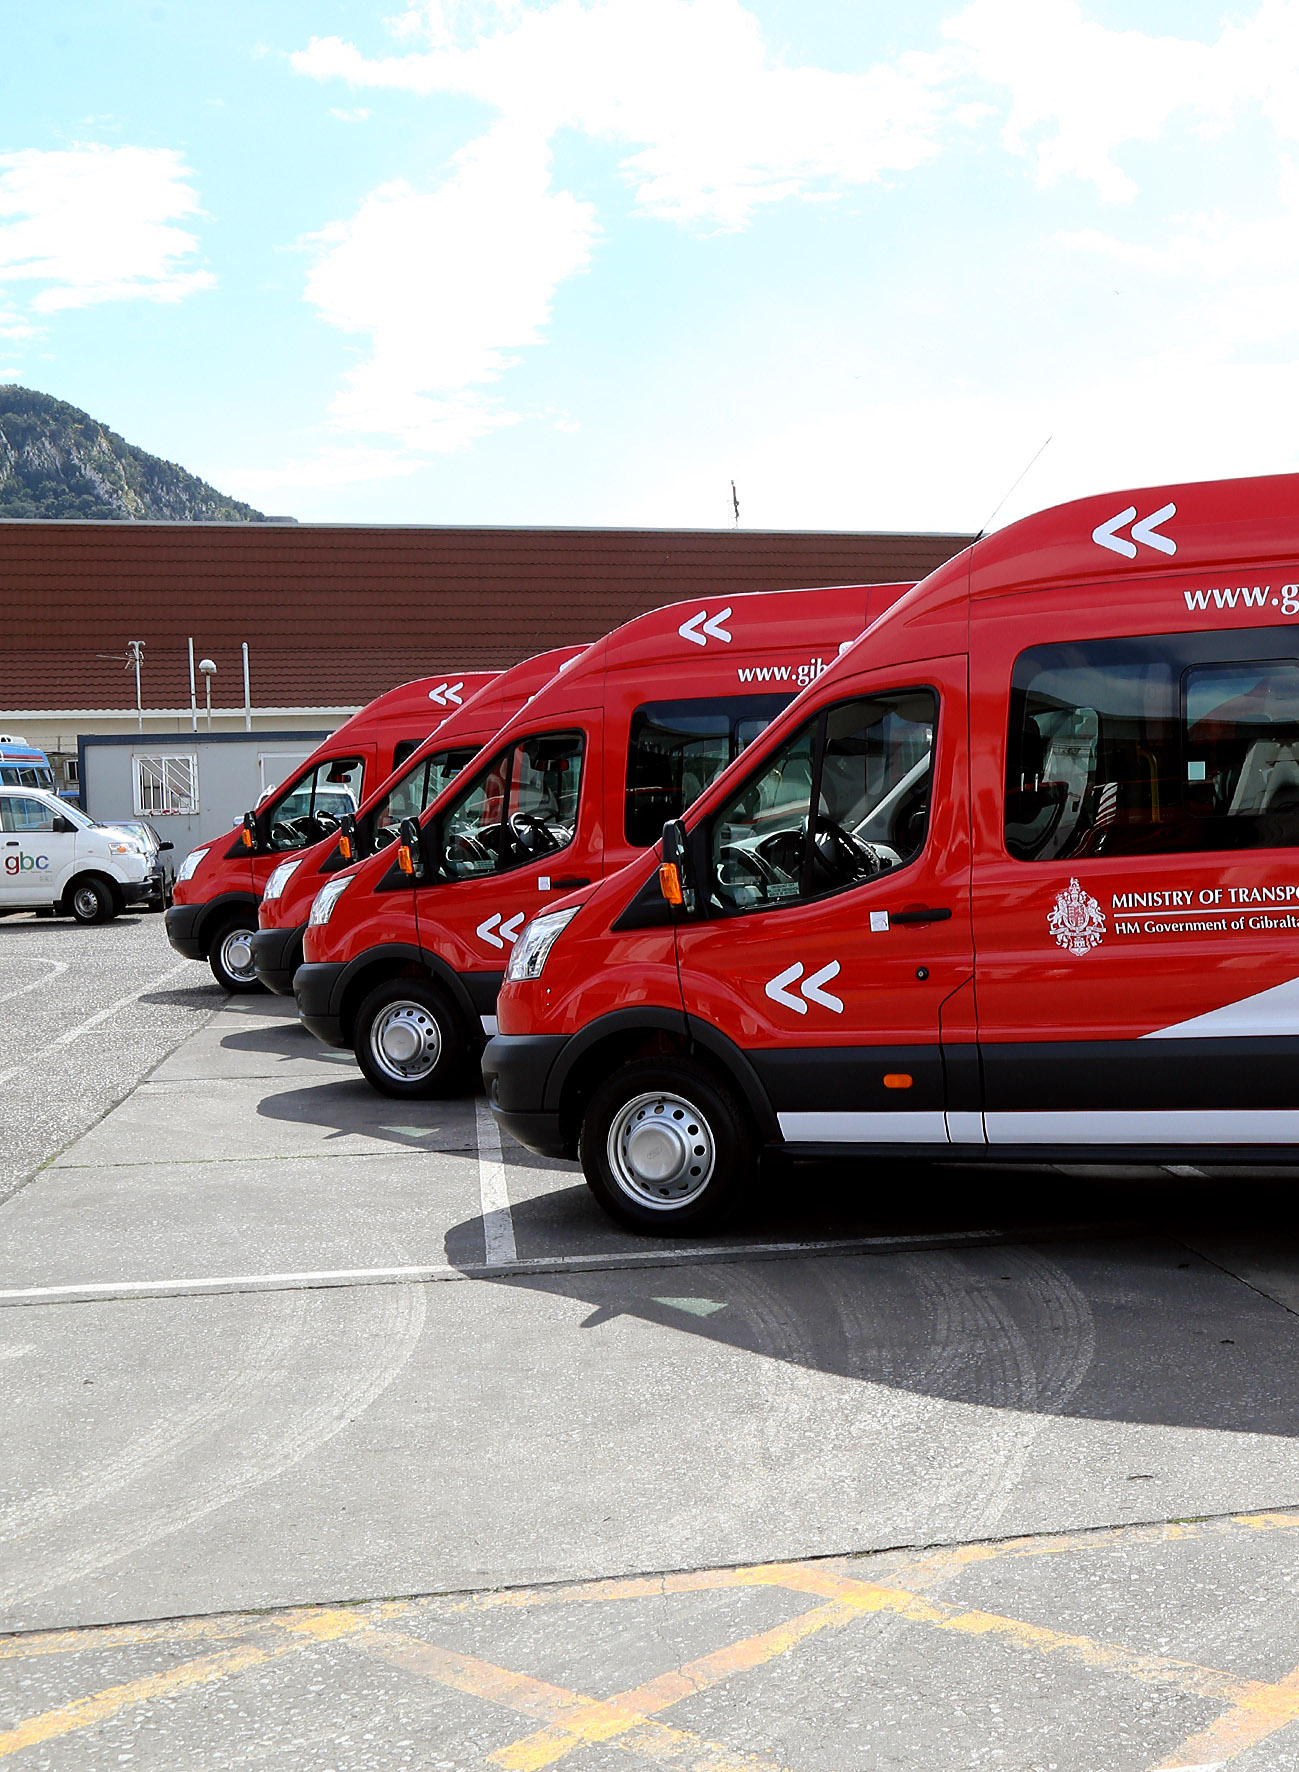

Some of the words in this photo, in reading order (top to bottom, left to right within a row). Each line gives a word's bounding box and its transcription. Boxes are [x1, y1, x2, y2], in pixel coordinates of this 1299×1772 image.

[5, 851, 50, 876] gbc
[1112, 890, 1194, 909] MINISTRY
[1199, 888, 1223, 905] OF
[1115, 921, 1141, 935] HM
[1144, 919, 1228, 933] Government
[1231, 916, 1245, 930] of
